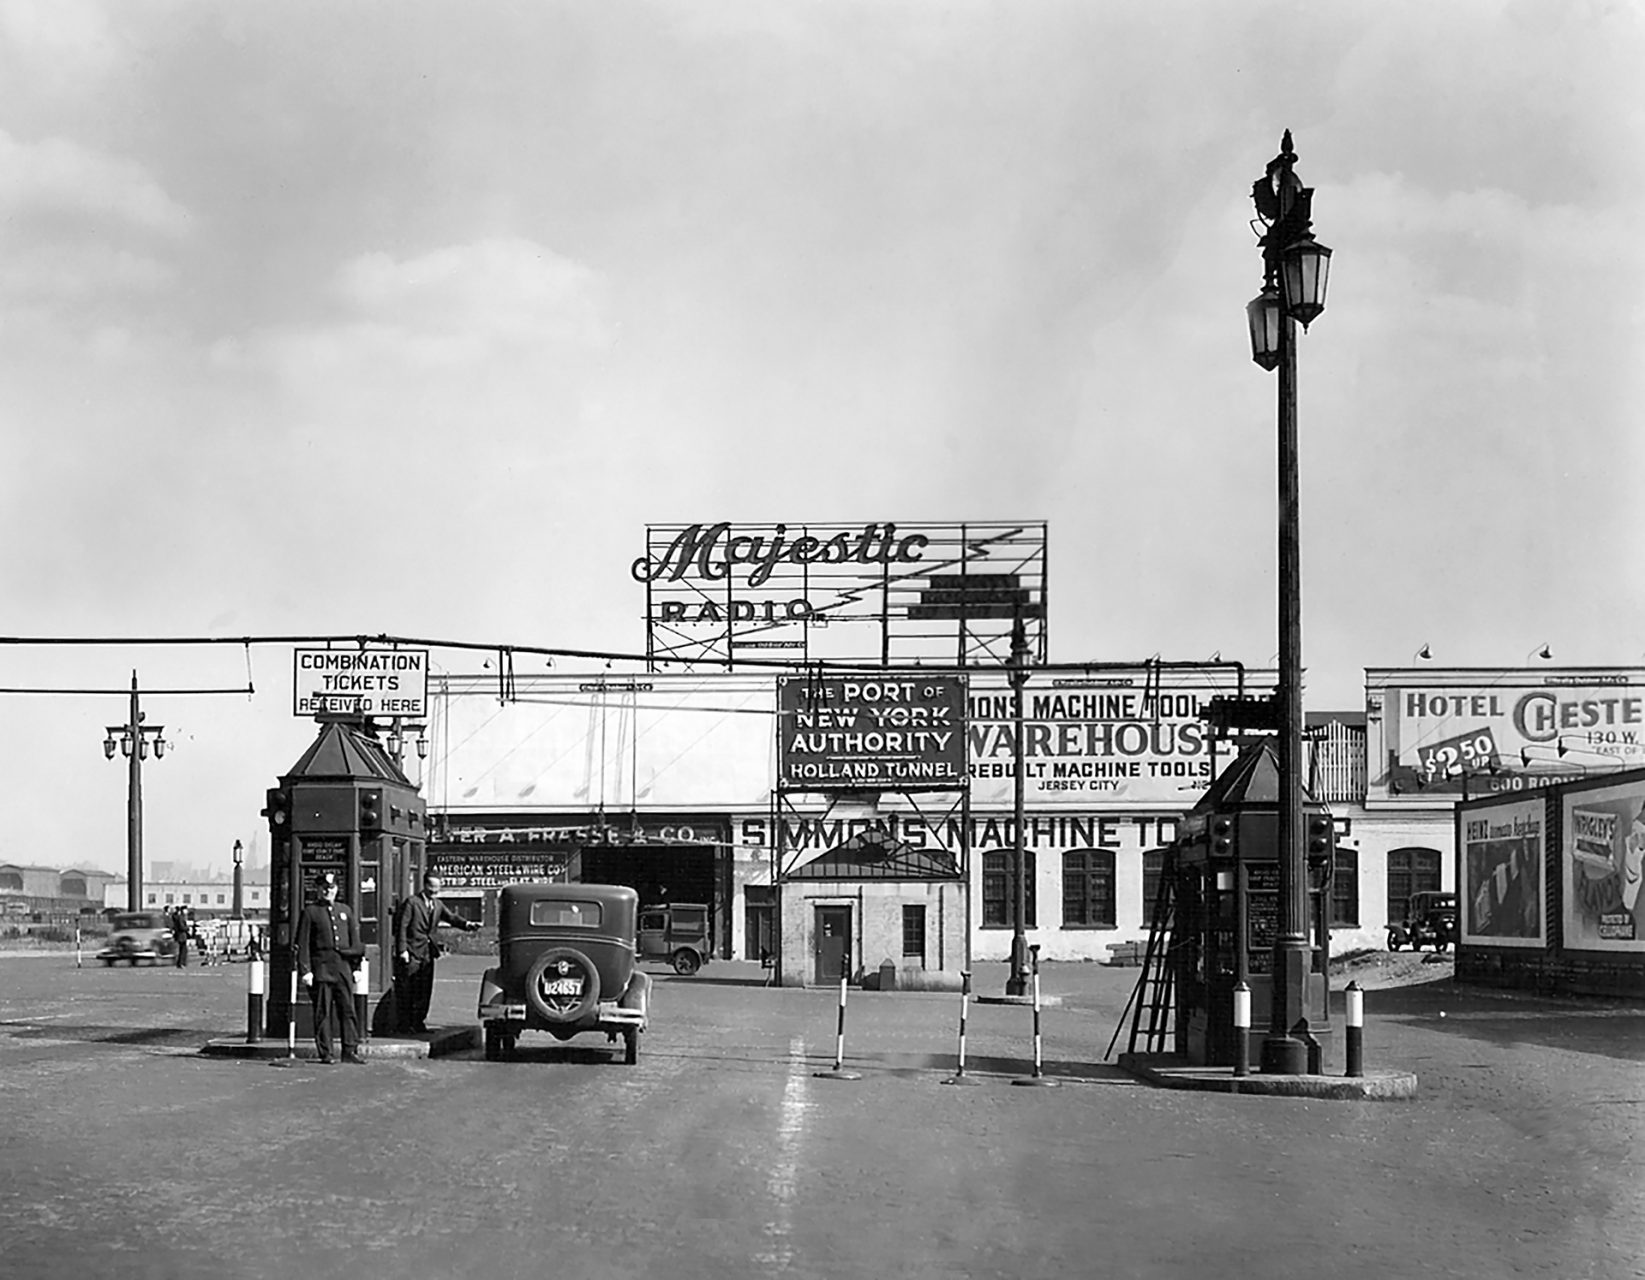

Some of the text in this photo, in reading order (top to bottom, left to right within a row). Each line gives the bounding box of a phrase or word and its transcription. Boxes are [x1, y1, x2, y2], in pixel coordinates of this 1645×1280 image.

[631, 521, 929, 587] Majestic
[661, 599, 813, 622] RADIO
[301, 654, 421, 670] COMBINATION
[322, 675, 399, 690] TICKETS
[802, 683, 945, 702] THE PORT OF
[381, 699, 421, 712] HERE
[1033, 695, 1135, 719] MACHINE
[1407, 694, 1504, 718] HOTEL
[796, 707, 950, 727] NEW YORK
[790, 732, 952, 753] AUTHORITY
[1588, 731, 1639, 745] 130 W.
[790, 762, 958, 778] HOLLAND TUNNEL
[968, 762, 1210, 778] REBULT MACHINE TOOLS
[1472, 755, 1490, 769] UP
[1038, 780, 1119, 791] JERSEY CITY
[946, 817, 1120, 848] MACHINE
[432, 864, 484, 876] AMERICAN
[486, 864, 515, 876] STEEL
[521, 864, 545, 876] WIRE
[440, 876, 467, 886] STRIP
[470, 876, 497, 886] STEEL
